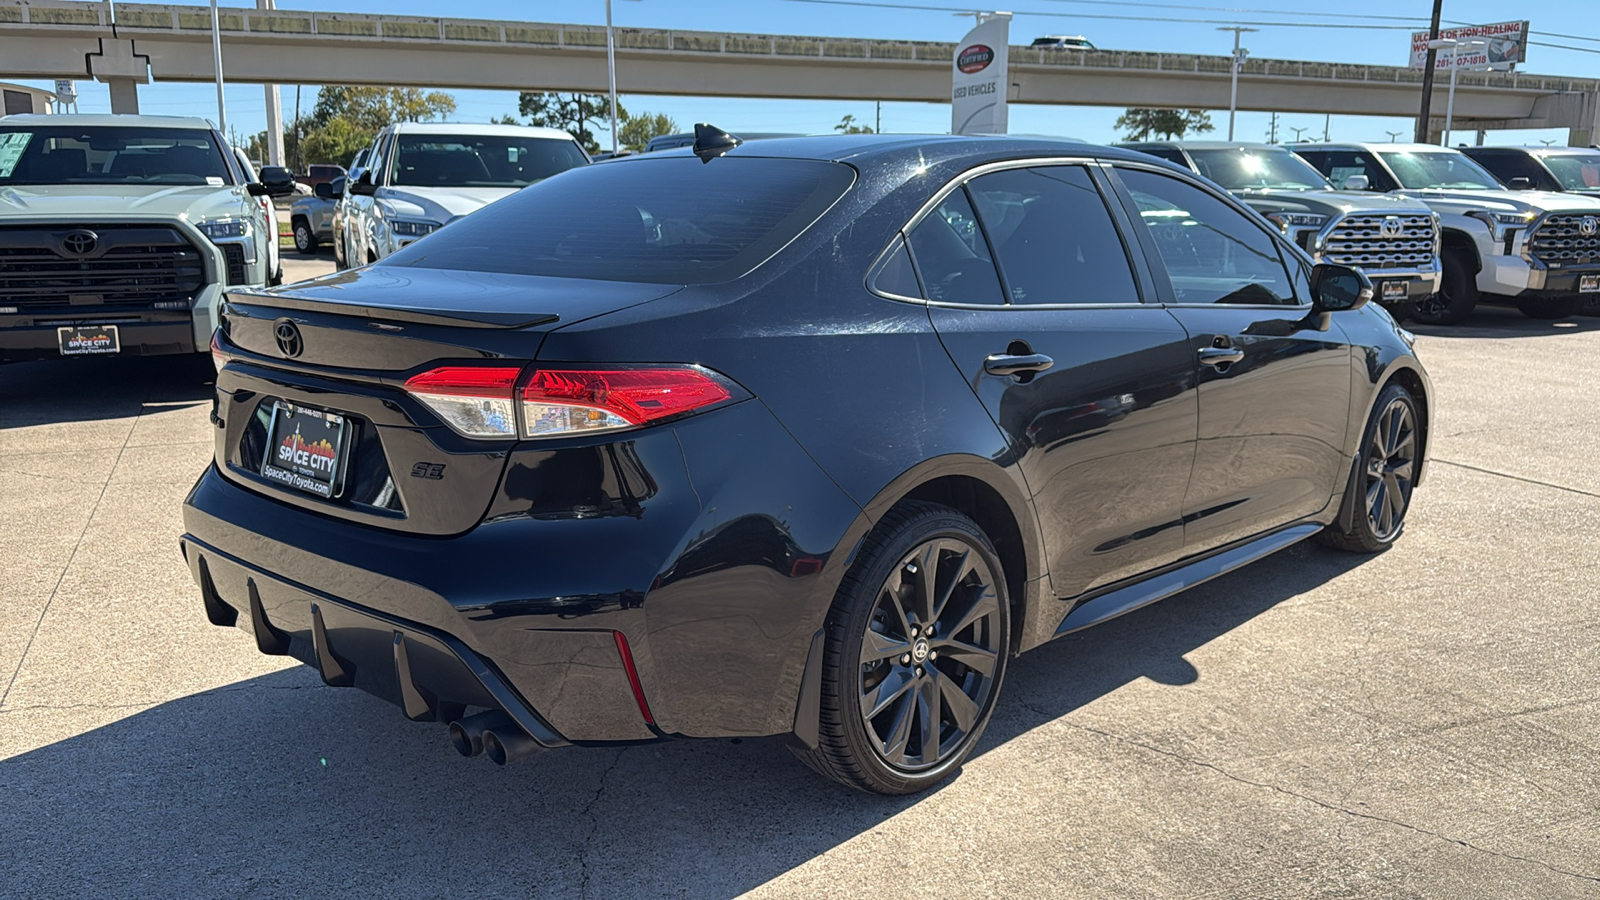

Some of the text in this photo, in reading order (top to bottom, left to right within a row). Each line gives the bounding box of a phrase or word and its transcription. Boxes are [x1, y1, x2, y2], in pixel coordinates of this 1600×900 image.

[1446, 30, 1458, 38] OR
[1460, 23, 1520, 37] NON-HEALING
[1436, 56, 1487, 68] 281-07-1818
[953, 82, 996, 99] USED VEHICLES
[278, 445, 335, 472] SPACE CITY
[298, 467, 315, 477] TOYOTA
[411, 461, 447, 480] SE
[264, 465, 329, 494] SpaceCityToyota.com
